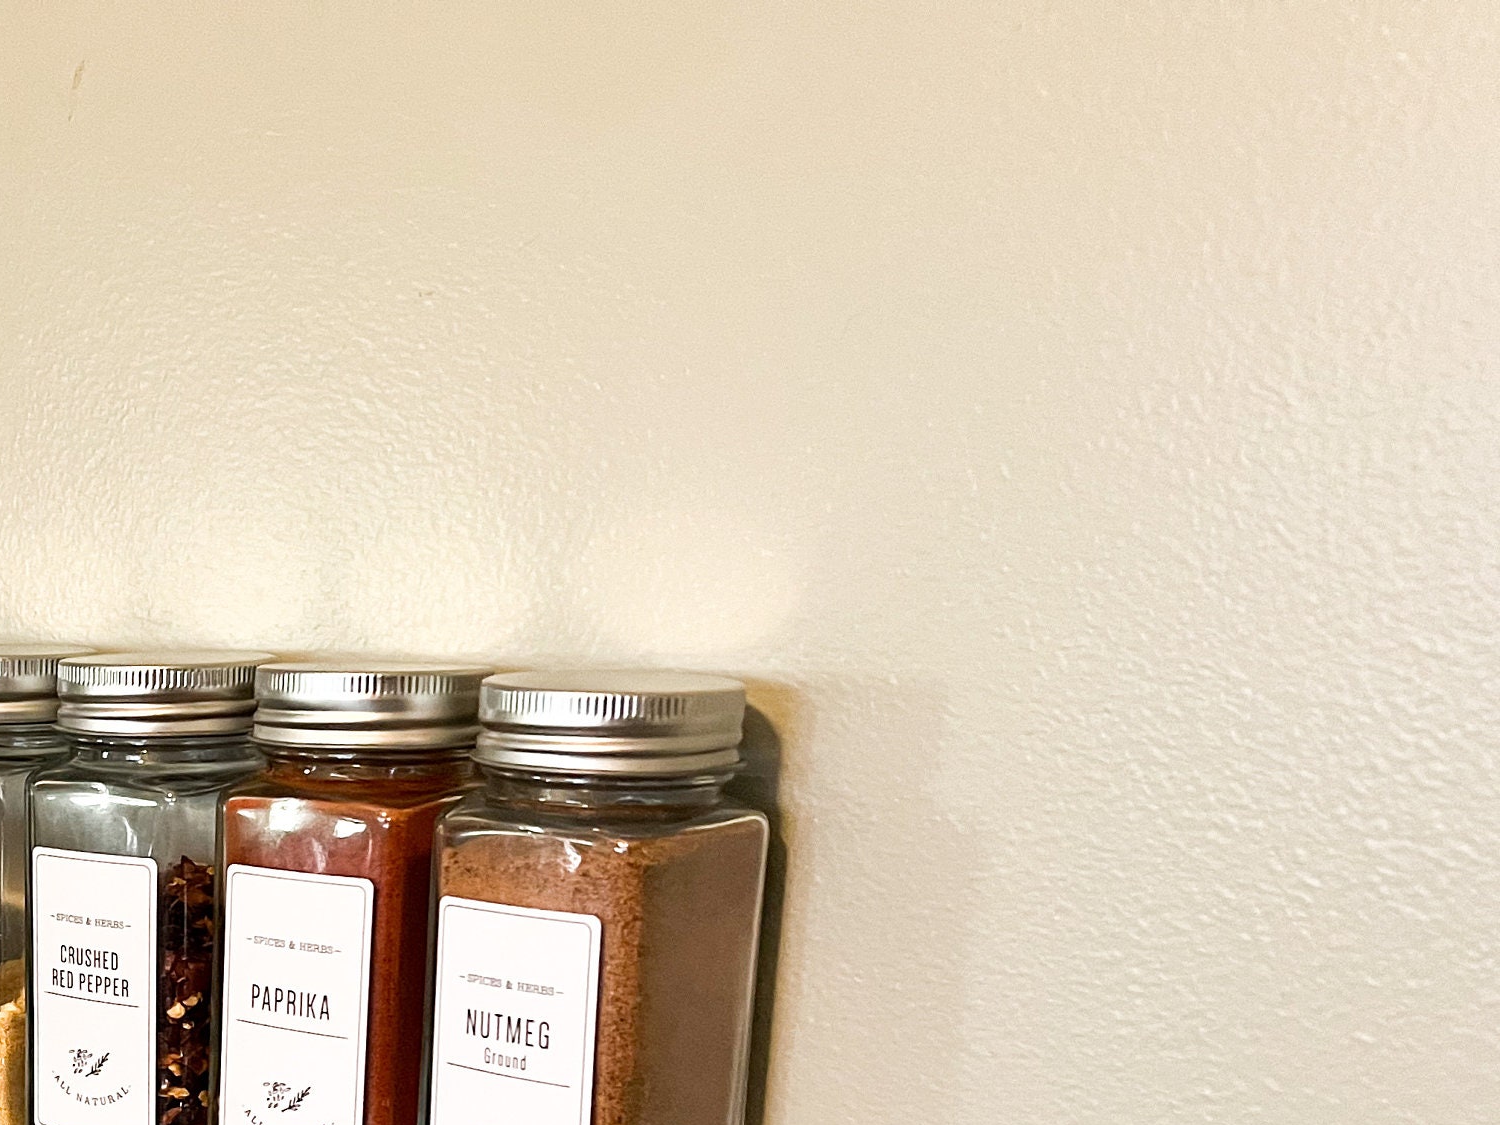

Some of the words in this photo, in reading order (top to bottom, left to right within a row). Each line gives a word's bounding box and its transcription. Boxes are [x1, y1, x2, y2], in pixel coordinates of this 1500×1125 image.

[56, 913, 84, 925] SPICES
[86, 917, 92, 926] &
[95, 918, 124, 930] HERBS
[60, 944, 119, 971] CRUSHED
[253, 936, 285, 948] SPICES
[289, 940, 296, 949] &
[299, 942, 333, 954] HERBS
[52, 968, 74, 989] RED
[79, 974, 129, 998] PEPPER
[467, 974, 502, 988] SPICES
[505, 980, 513, 990] &
[517, 981, 555, 996] HERBS
[251, 983, 331, 1021] PAPRIKA
[466, 1009, 551, 1050] NUTMEG
[484, 1047, 527, 1071] Ground
[54, 1074, 72, 1096] ALL
[76, 1086, 128, 1106] NATURAL
